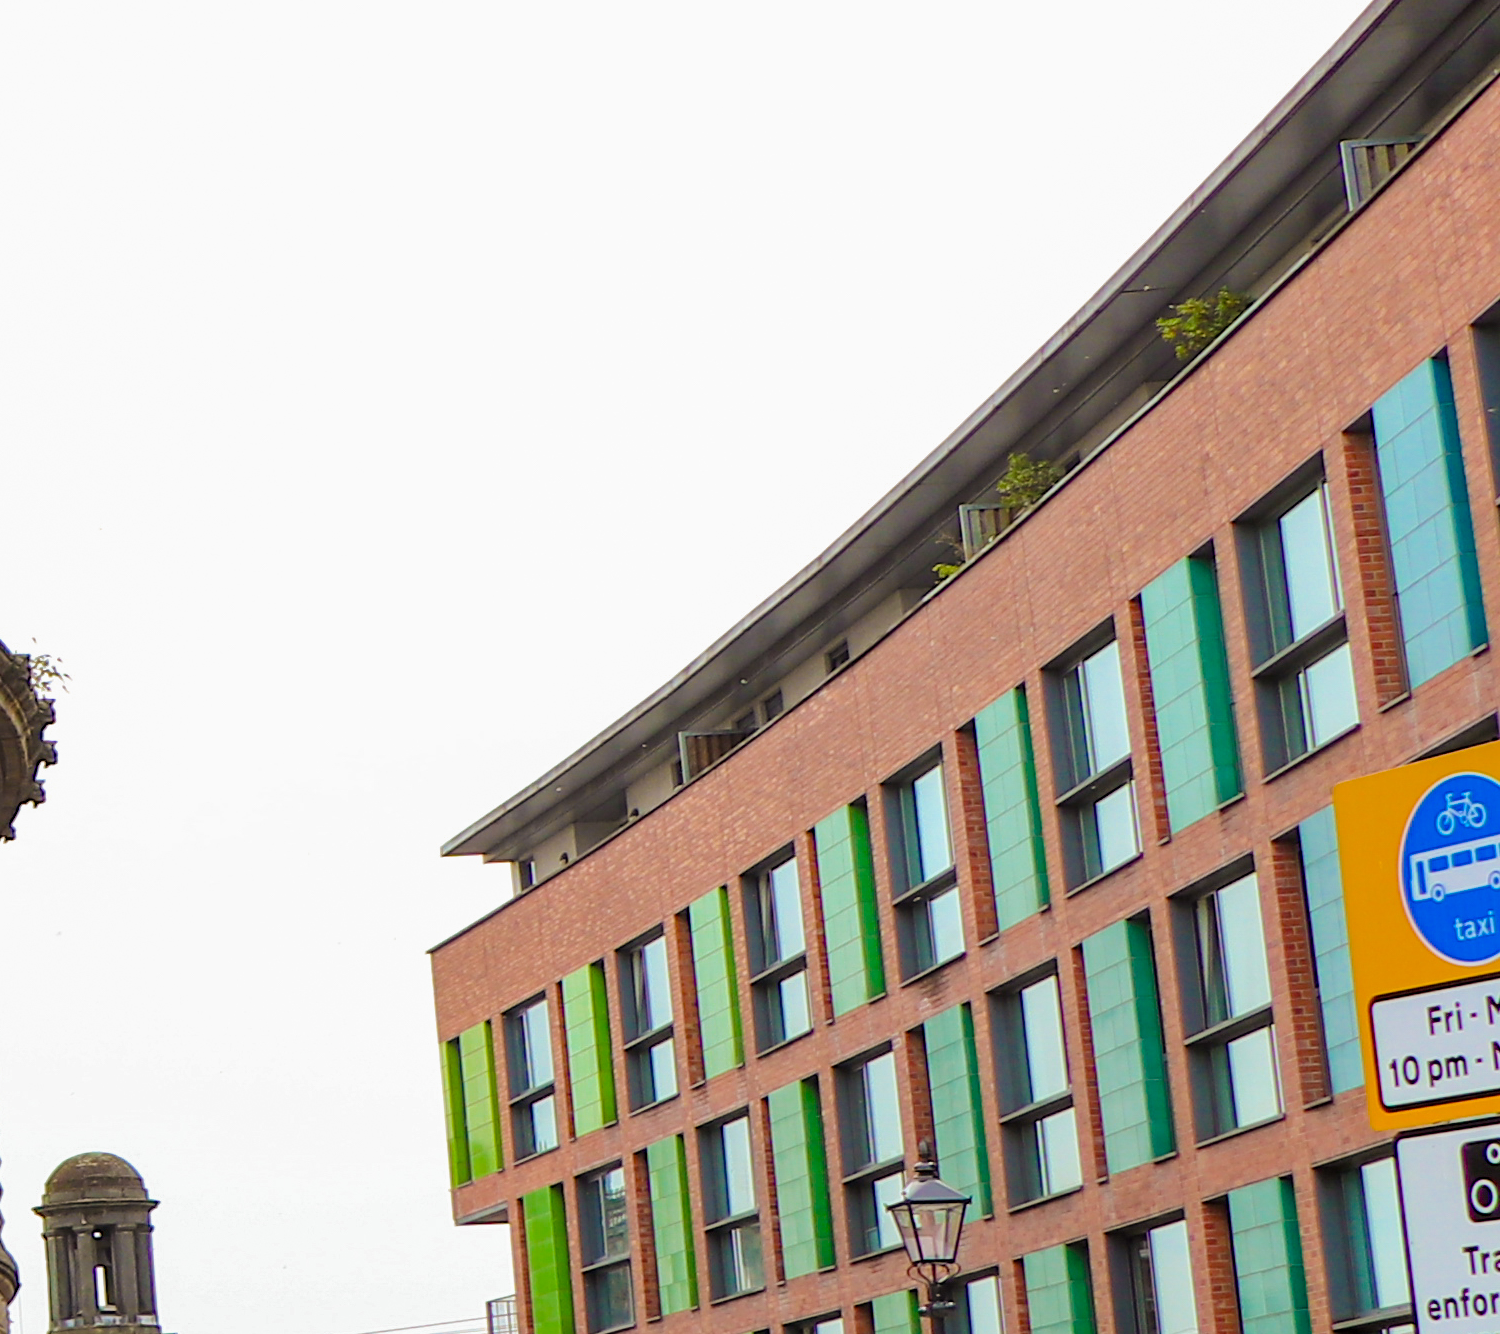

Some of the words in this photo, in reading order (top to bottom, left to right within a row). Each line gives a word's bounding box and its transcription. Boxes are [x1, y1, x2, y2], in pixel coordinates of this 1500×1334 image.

[1454, 910, 1496, 941] taxi
[1427, 1001, 1463, 1036] Fri
[1389, 1055, 1420, 1088] 10
[1427, 1055, 1469, 1088] pm
